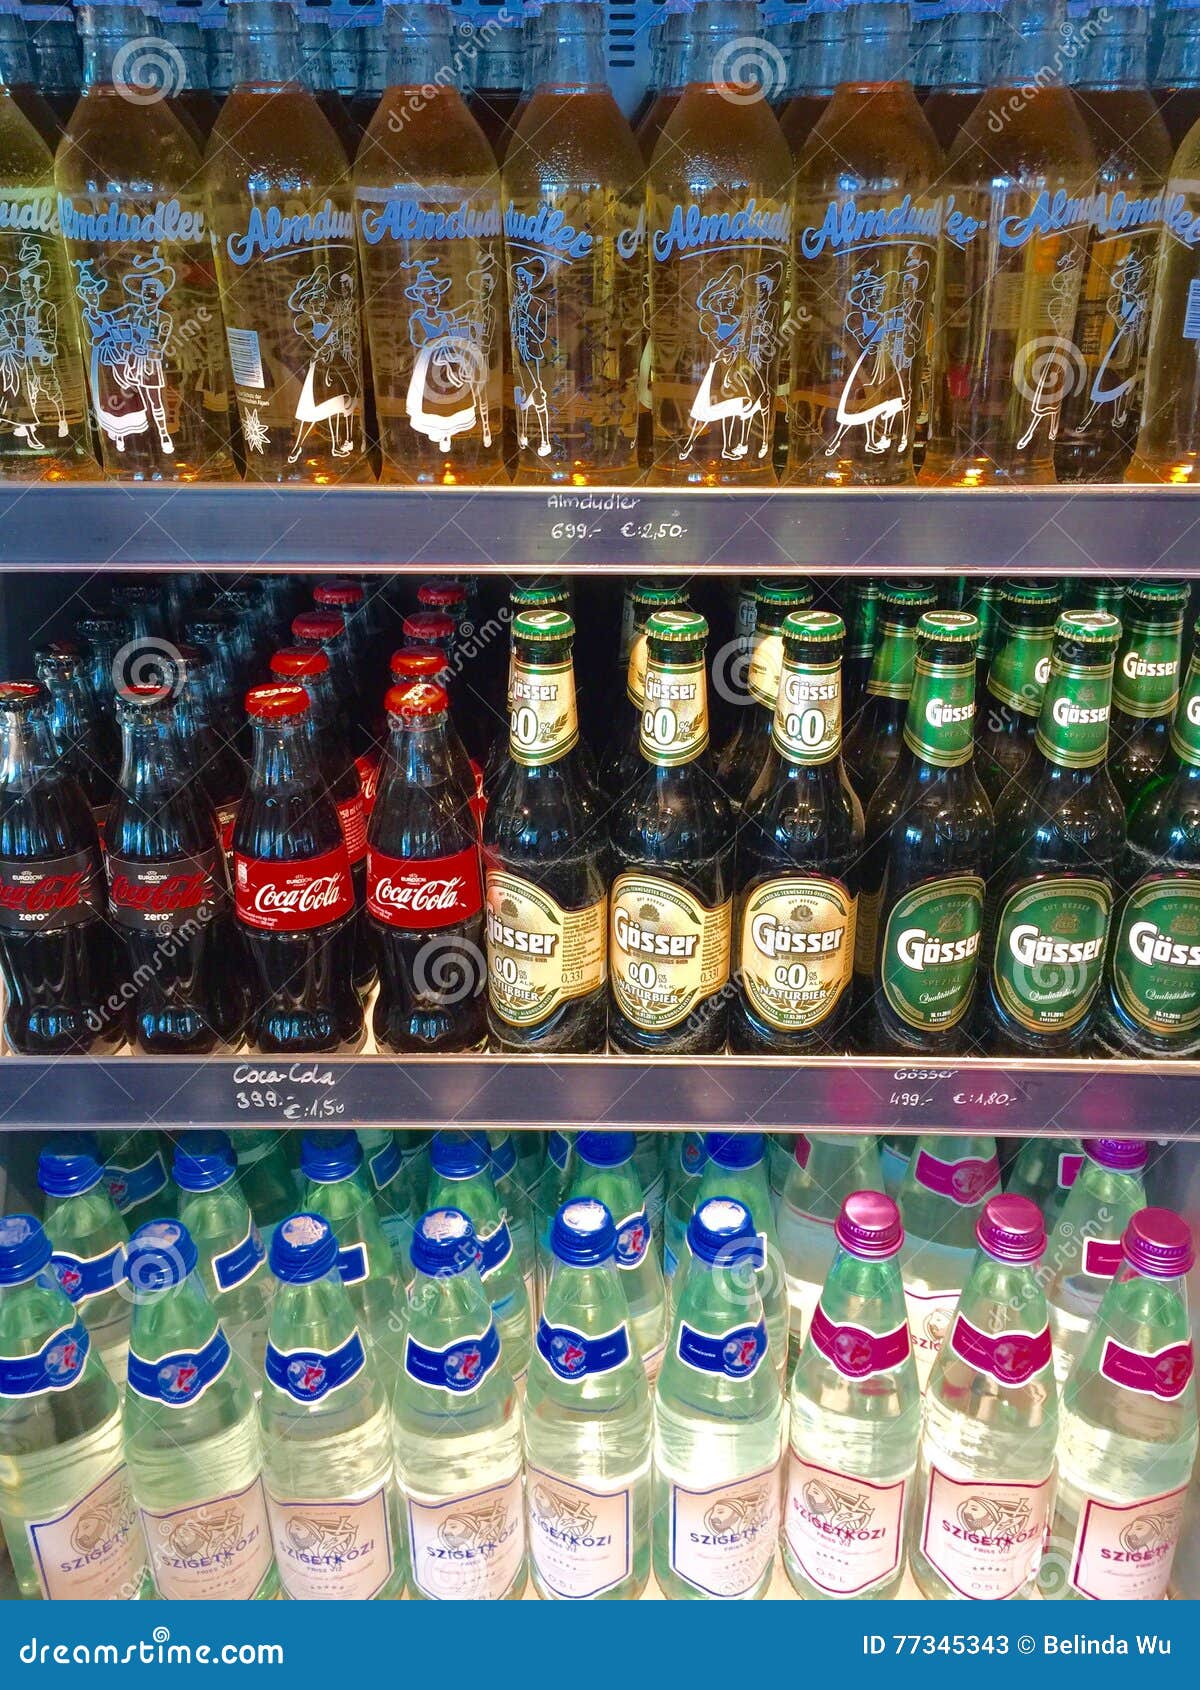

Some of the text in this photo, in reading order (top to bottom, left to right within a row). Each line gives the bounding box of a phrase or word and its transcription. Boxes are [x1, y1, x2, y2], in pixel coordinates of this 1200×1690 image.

[547, 493, 641, 510] Almdudler
[1122, 652, 1178, 680] Gösser
[645, 670, 697, 703] Gösser
[255, 872, 342, 914] Coca-Cola
[376, 876, 463, 912] Coca-Cola
[615, 907, 699, 957] Gösser
[752, 913, 845, 958] Gösser
[1009, 924, 1104, 967] Gösser
[897, 928, 982, 971] Gösser
[758, 983, 828, 1001] NATURBIER
[233, 1063, 335, 1086] Coca-Cola
[894, 1069, 958, 1081] Gösser
